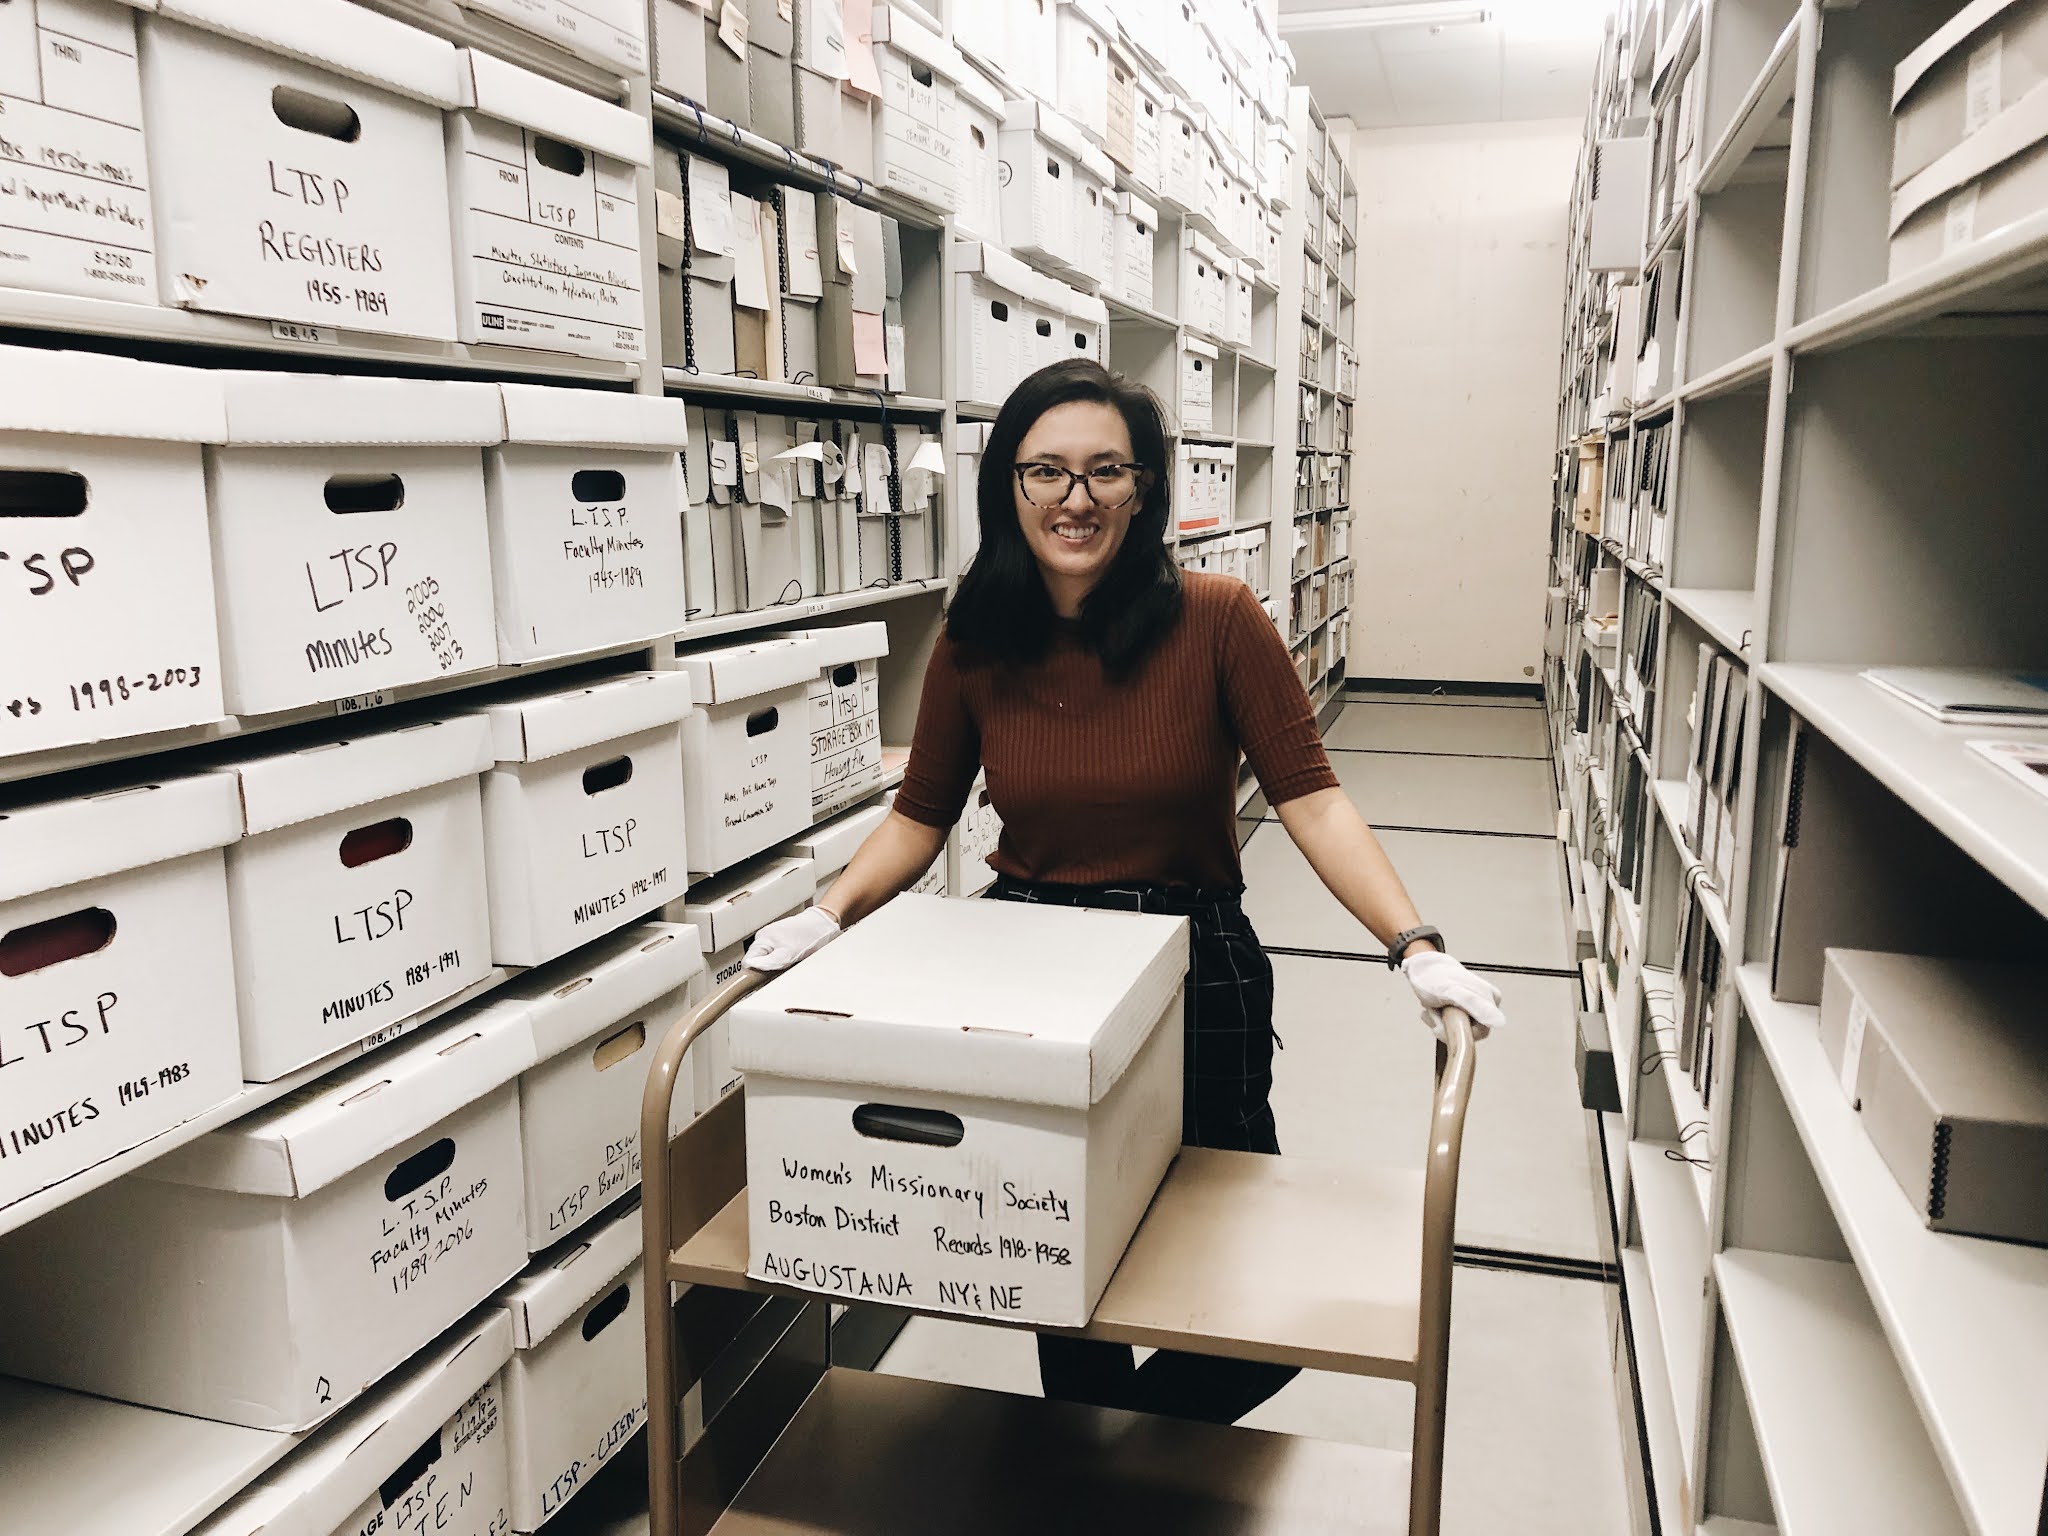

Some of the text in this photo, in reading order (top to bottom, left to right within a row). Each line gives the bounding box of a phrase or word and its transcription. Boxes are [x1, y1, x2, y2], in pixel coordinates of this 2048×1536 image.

[52, 41, 82, 64] THRU
[267, 159, 350, 213] LTSP
[499, 169, 519, 184] FROM
[538, 201, 576, 227] LTSP
[258, 219, 383, 272] REGISTERS
[554, 233, 584, 249] CONTENTS
[481, 312, 504, 330] ULINE
[0, 547, 95, 596] SP
[306, 542, 398, 613] LTSP
[405, 575, 440, 614] 2005
[70, 666, 201, 711] 1998-2003
[750, 753, 768, 768] LTSP
[811, 728, 846, 757] STORAGE
[582, 818, 637, 859] LTSP
[334, 889, 413, 944] LTSP
[573, 888, 627, 925] MINUTES
[716, 960, 742, 985] STORAG
[322, 980, 395, 1024] MINUTES
[0, 991, 118, 1069] LTSP
[549, 1185, 590, 1231] LTSP
[782, 1157, 1070, 1221] Women's Missionary Society
[370, 1178, 489, 1274] Faculty Minutes
[769, 1200, 900, 1237] Boston District
[933, 1226, 993, 1256] Records
[764, 1252, 913, 1296] AUGUSTANA
[396, 1474, 437, 1530] LTSP
